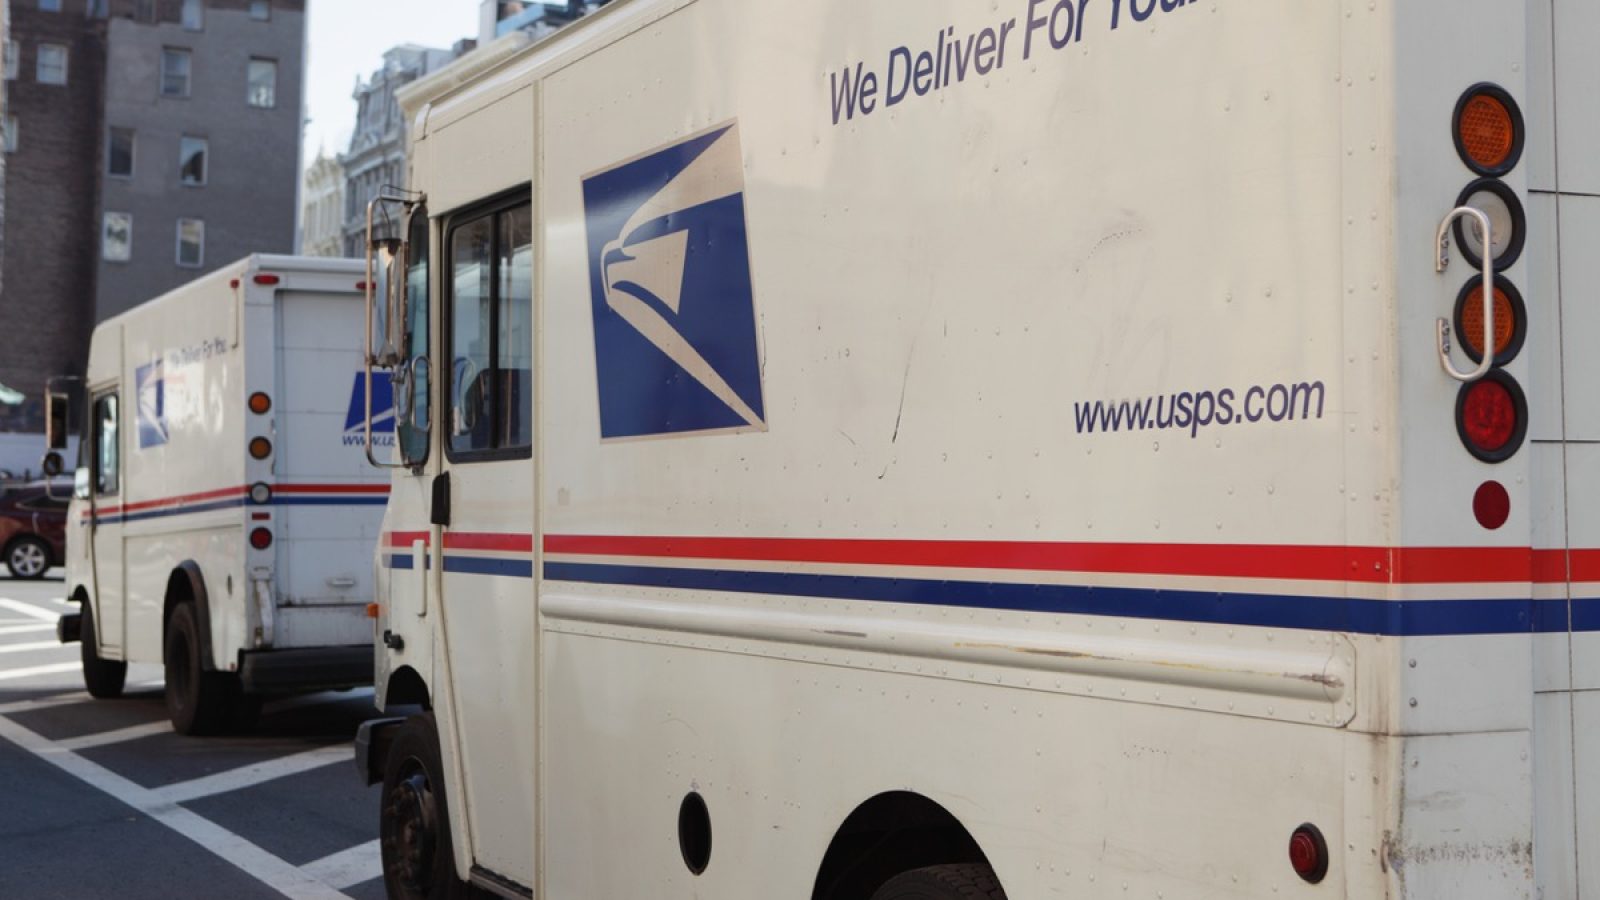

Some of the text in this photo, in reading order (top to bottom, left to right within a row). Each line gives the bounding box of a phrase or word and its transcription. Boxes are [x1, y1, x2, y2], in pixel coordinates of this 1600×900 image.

[830, 62, 878, 126] We
[885, 18, 1016, 108] Deliver
[1022, 0, 1090, 61] For
[1074, 380, 1325, 438] www.usps.com
